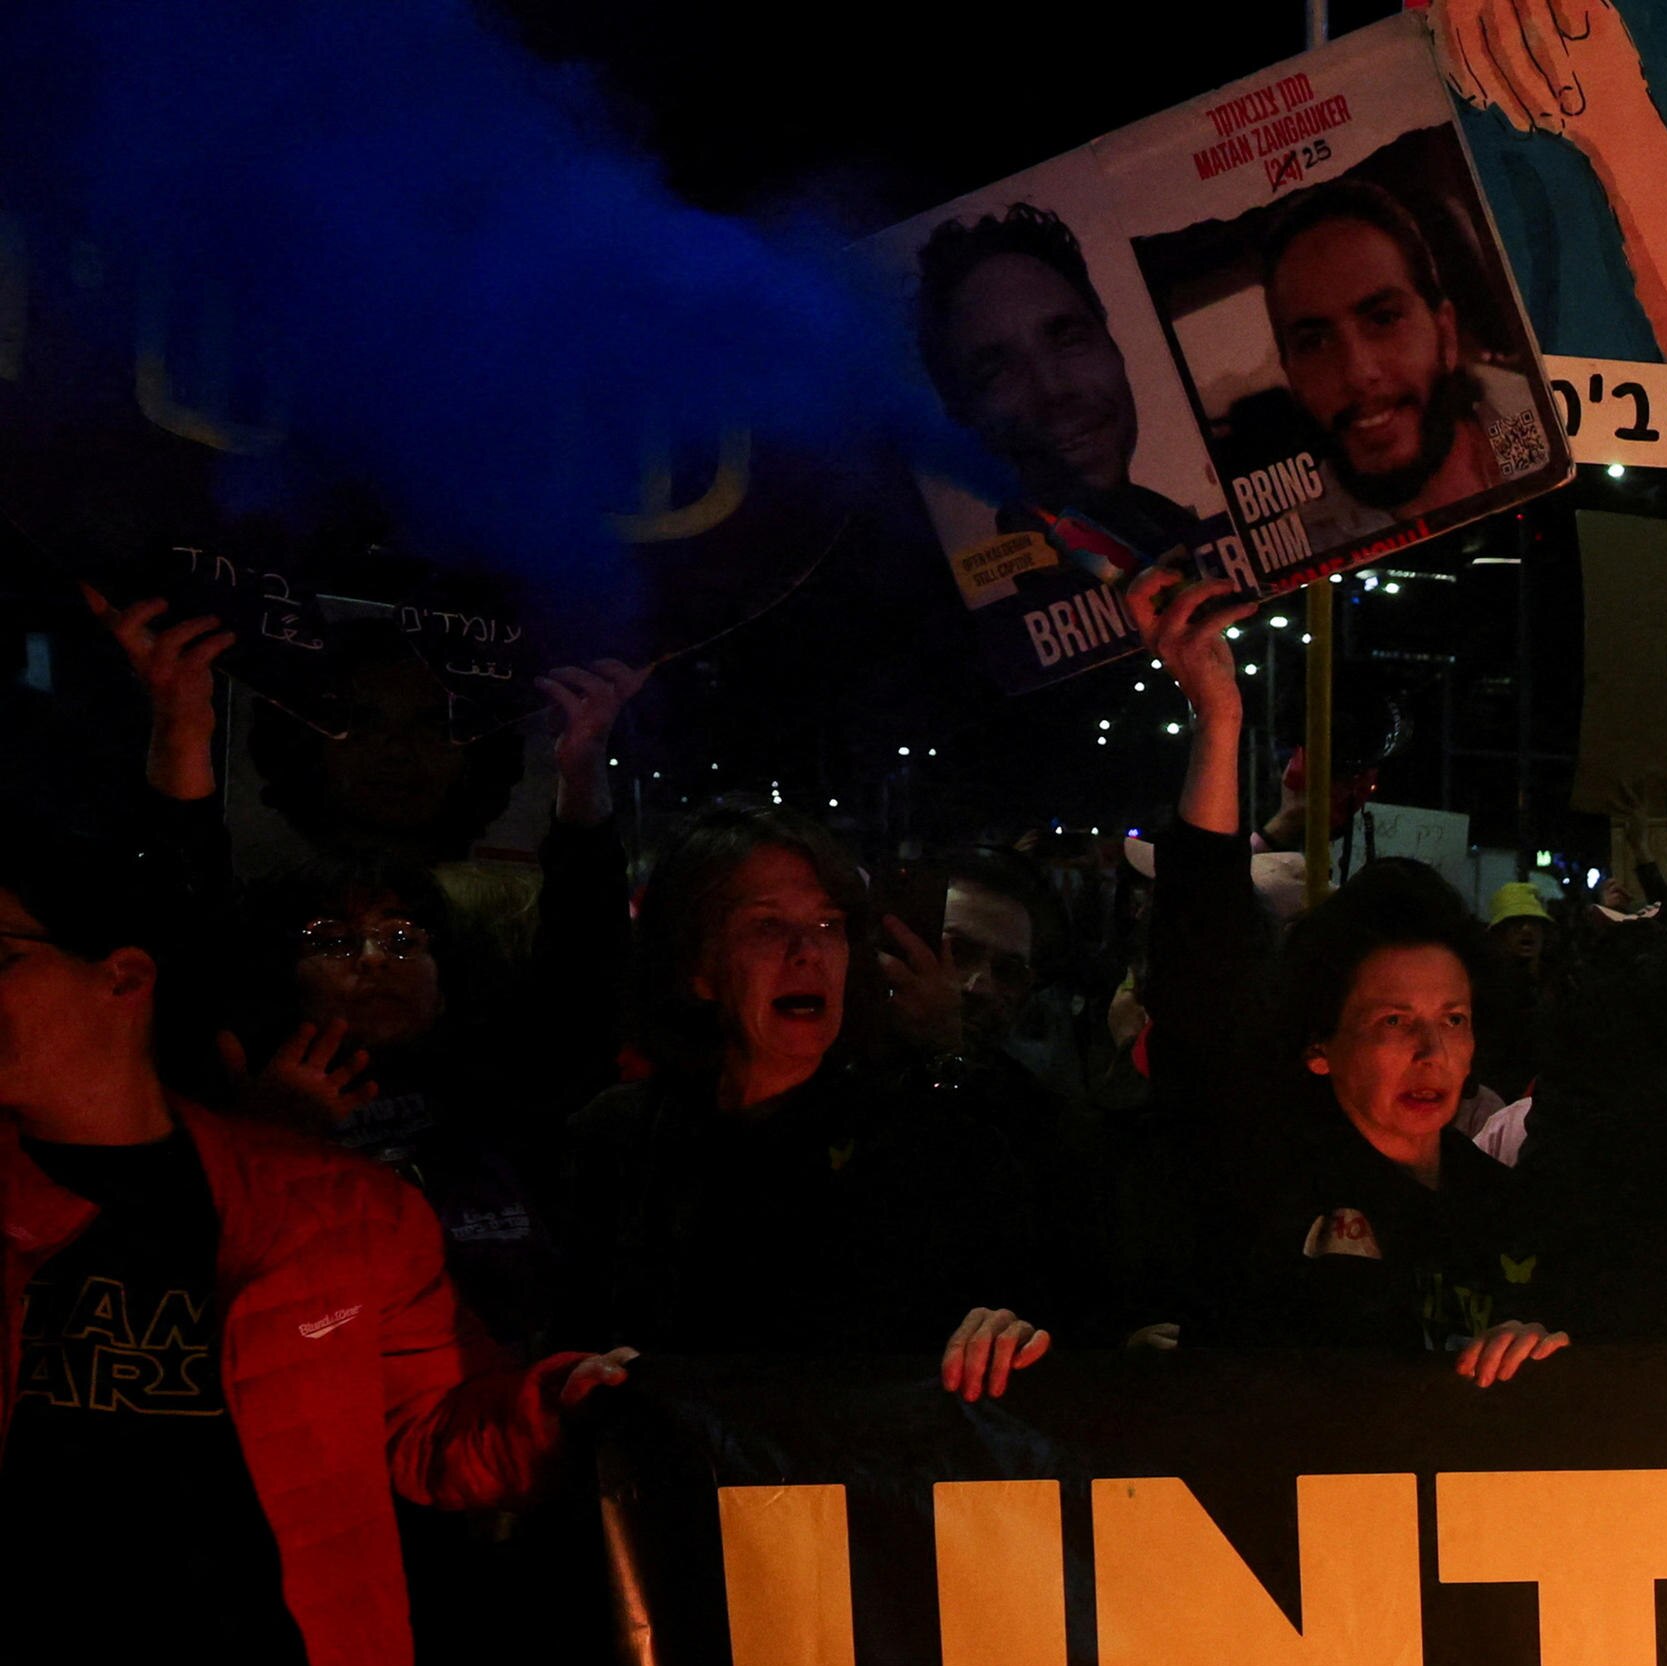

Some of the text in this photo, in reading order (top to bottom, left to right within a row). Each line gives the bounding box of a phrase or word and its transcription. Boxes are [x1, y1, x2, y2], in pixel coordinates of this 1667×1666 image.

[1192, 94, 1352, 181] MATAN ZANGAUKER
[1205, 72, 1314, 138] מתן צנגאוקר
[1302, 138, 1333, 170] 25
[1231, 450, 1326, 525] BRING
[1249, 511, 1313, 575] HIM
[171, 545, 523, 643] עומדים ביחד
